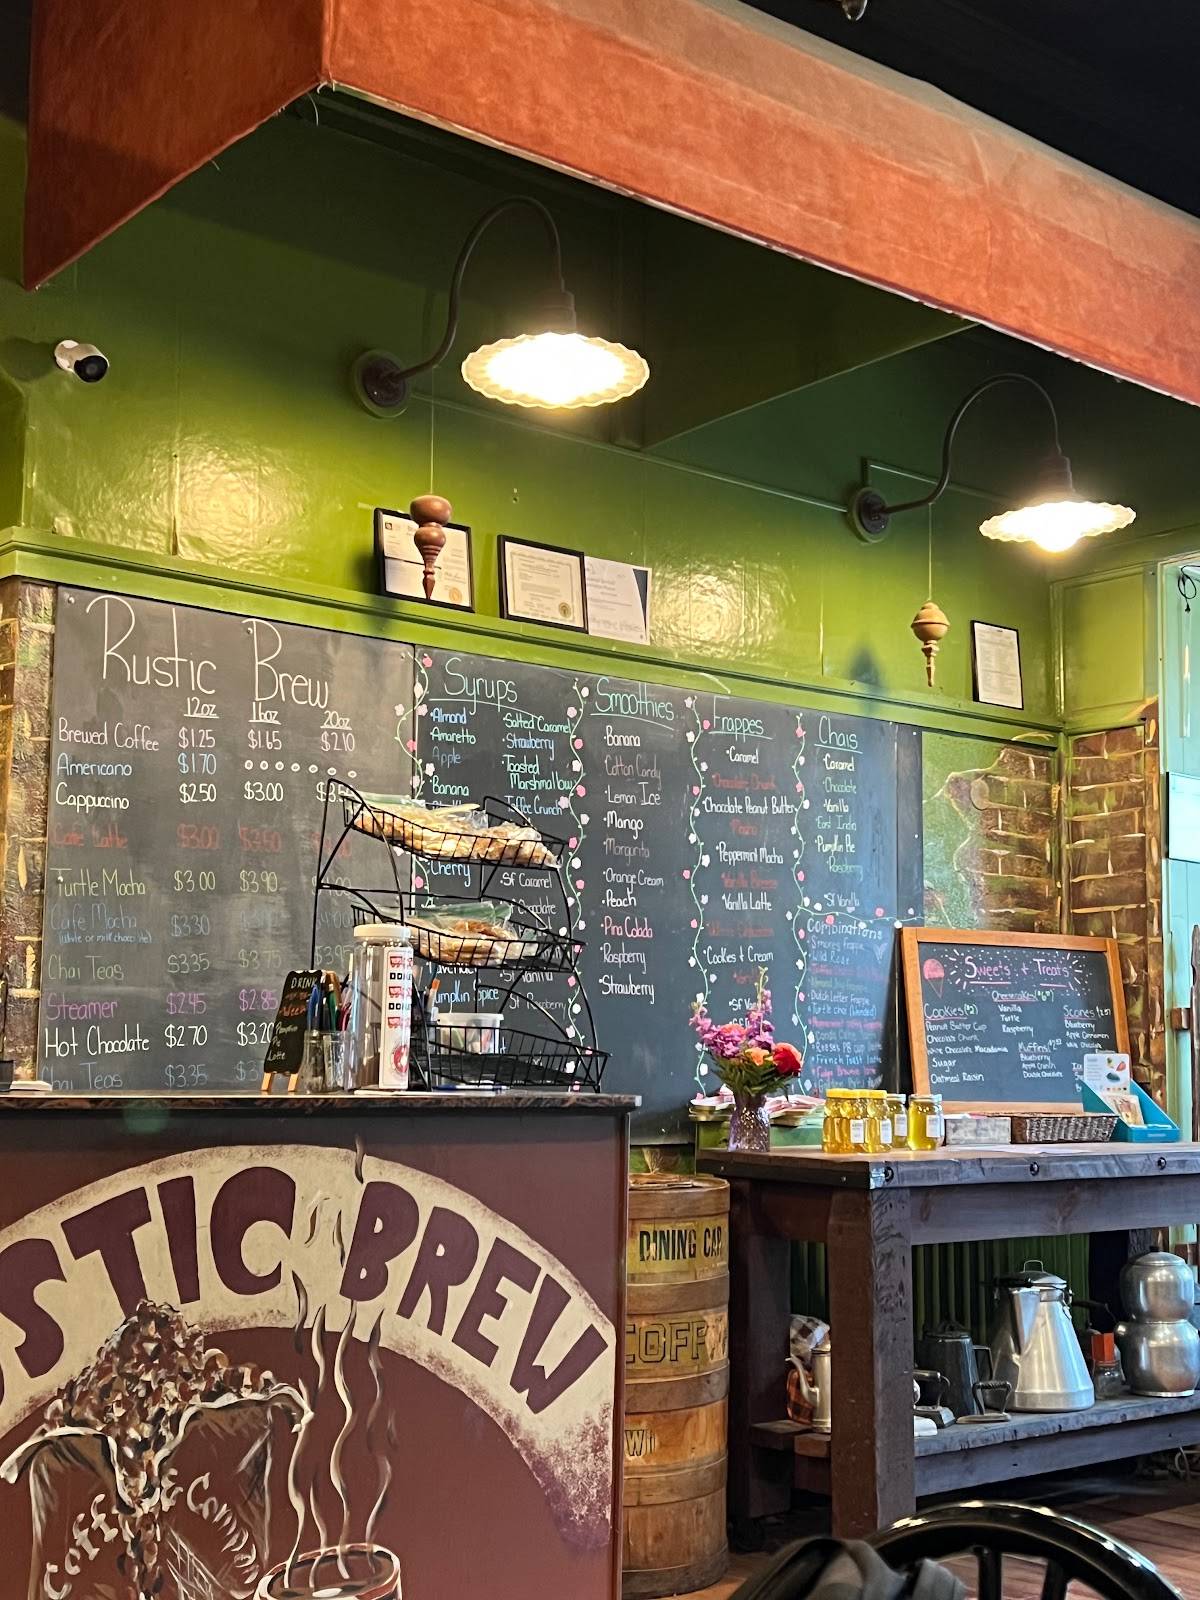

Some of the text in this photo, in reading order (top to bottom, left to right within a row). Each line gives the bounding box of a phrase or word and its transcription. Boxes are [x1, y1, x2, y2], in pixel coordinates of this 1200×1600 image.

[86, 595, 328, 708] Rustic Brew
[444, 657, 518, 715] Syrups
[595, 677, 675, 721] Smoothies
[185, 696, 217, 717] 12oz
[322, 709, 351, 729] 20oz
[431, 707, 467, 725] Almond
[504, 713, 572, 734] Salted Caramel
[713, 695, 765, 743] Frappes
[58, 717, 107, 744] Brewed
[114, 722, 159, 752] Coffee
[179, 726, 216, 749] $1.25
[431, 727, 477, 745] Amaretto
[605, 725, 641, 747] Banana
[818, 715, 858, 750] Chais
[432, 746, 463, 768] Apple
[506, 731, 555, 761] Strawberry
[728, 745, 760, 765] Caramel
[56, 752, 132, 777] Americano
[503, 754, 540, 775] Toasted
[605, 754, 661, 791] Cotton Candy
[431, 775, 470, 797] Banana
[509, 770, 573, 791] Marshmallow
[55, 782, 129, 813] Cappuccino
[243, 780, 284, 802] $3.00
[607, 781, 661, 806] Lemon Ice
[703, 795, 796, 815] Chocolate Peanut Butter
[823, 799, 850, 814] Vanilla
[606, 810, 644, 840] Mango
[758, 847, 784, 864] Mocha
[50, 868, 99, 897] Turtle
[102, 868, 146, 897] Mocha
[429, 861, 472, 888] Cherry
[518, 872, 552, 888] Caramel
[604, 867, 664, 893] Orange Cream
[605, 888, 637, 907] Peach
[723, 891, 772, 911] Vanilla Latte
[604, 915, 653, 938] Pina Colada
[806, 917, 883, 940] Combinations
[602, 942, 647, 974] Raspberry
[706, 945, 774, 965] Cookies Cream
[964, 955, 1011, 978] Sweets
[1032, 958, 1070, 977] Treats
[48, 954, 82, 980] Chai
[85, 955, 124, 981] Teas
[435, 979, 470, 1014] umpkin
[601, 974, 655, 1005] Strawberry
[45, 992, 118, 1021] Steamer
[997, 1004, 1023, 1013] Vanilla
[1063, 1004, 1095, 1017] Scones
[1001, 1024, 1035, 1038] Raspberry
[1064, 1019, 1096, 1032] Blueberry
[45, 1026, 78, 1058] Hot
[87, 1023, 150, 1057] Chocolate
[931, 1057, 957, 1073] Sugar
[961, 1072, 985, 1083] Raisin
[639, 1225, 723, 1263] DINING CAR
[0, 1166, 609, 1415] STIC BREW
